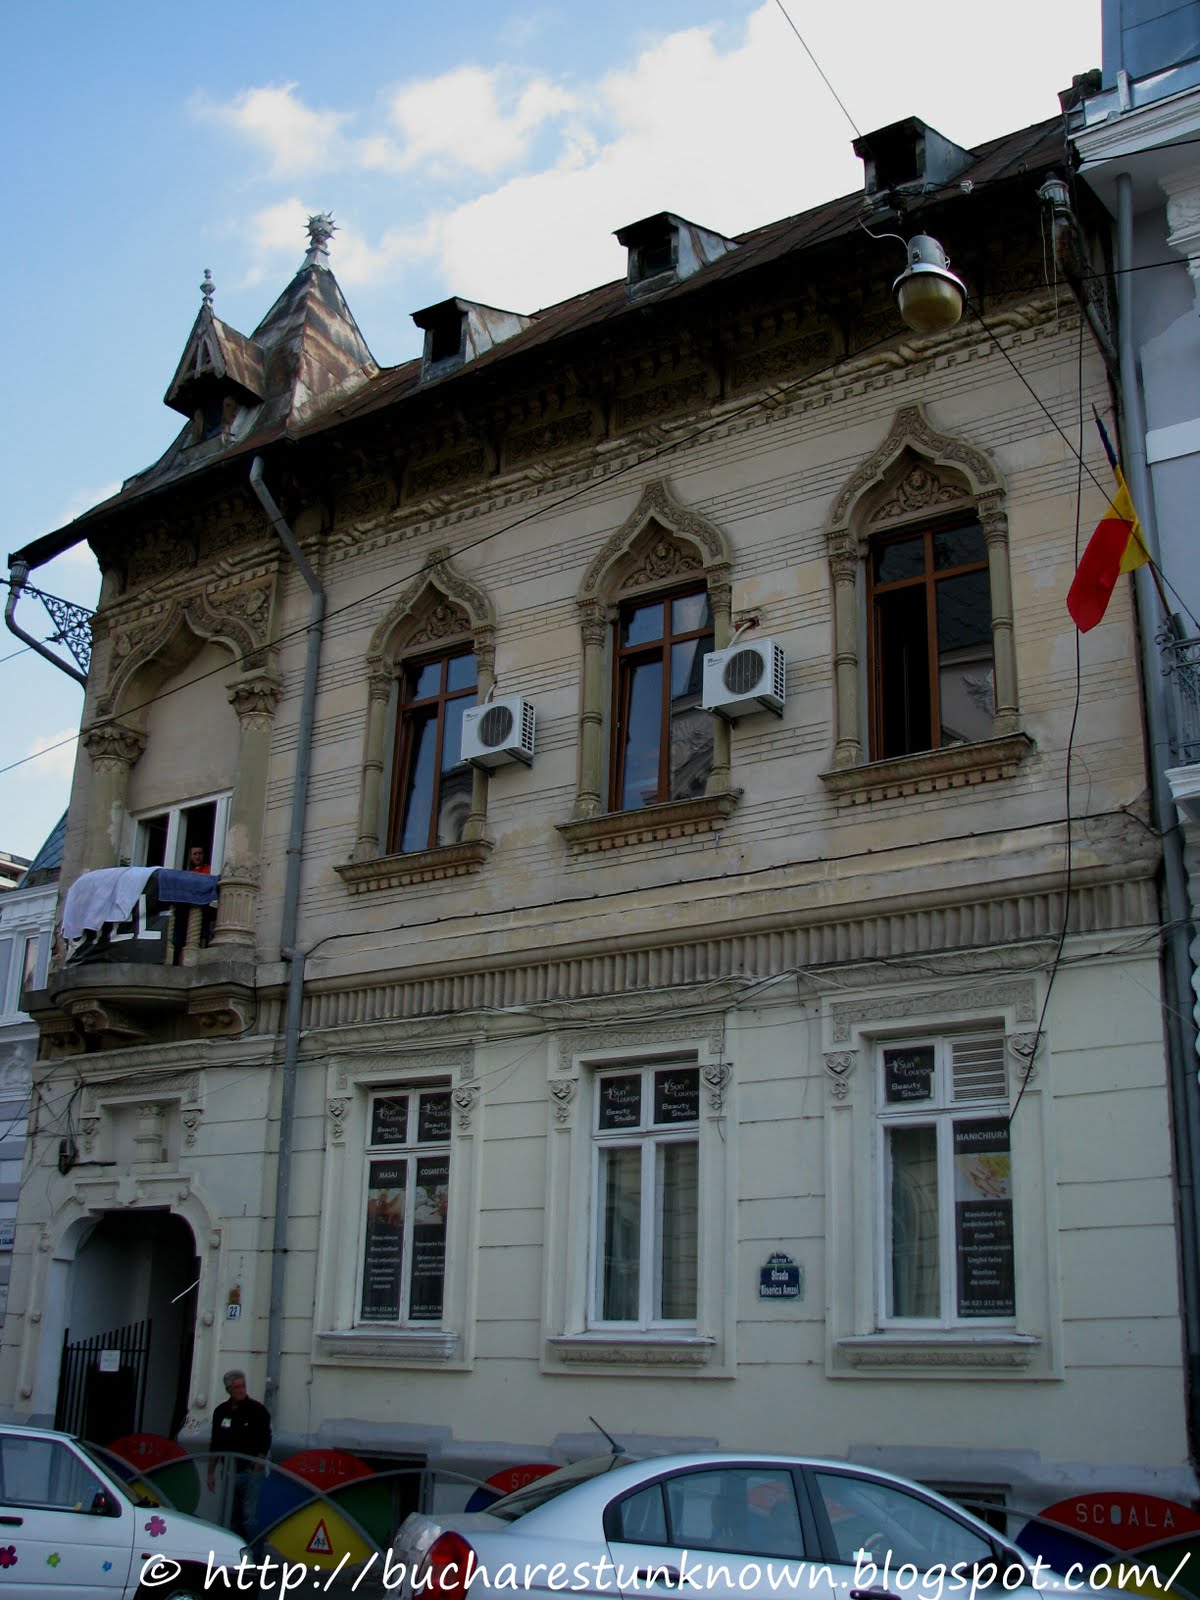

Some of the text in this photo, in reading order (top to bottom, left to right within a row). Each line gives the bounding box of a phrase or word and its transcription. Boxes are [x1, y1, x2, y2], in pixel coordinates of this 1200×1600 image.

[898, 1060, 915, 1069] Sun
[670, 1081, 685, 1090] Sun
[891, 1082, 921, 1091] Beauty
[431, 1103, 444, 1111] Sun
[606, 1108, 631, 1116] Beauty
[377, 1126, 399, 1134] Beauty
[379, 1171, 398, 1179] MASAJ
[771, 1269, 789, 1280] Strada
[1075, 1502, 1175, 1528] SCOALA
